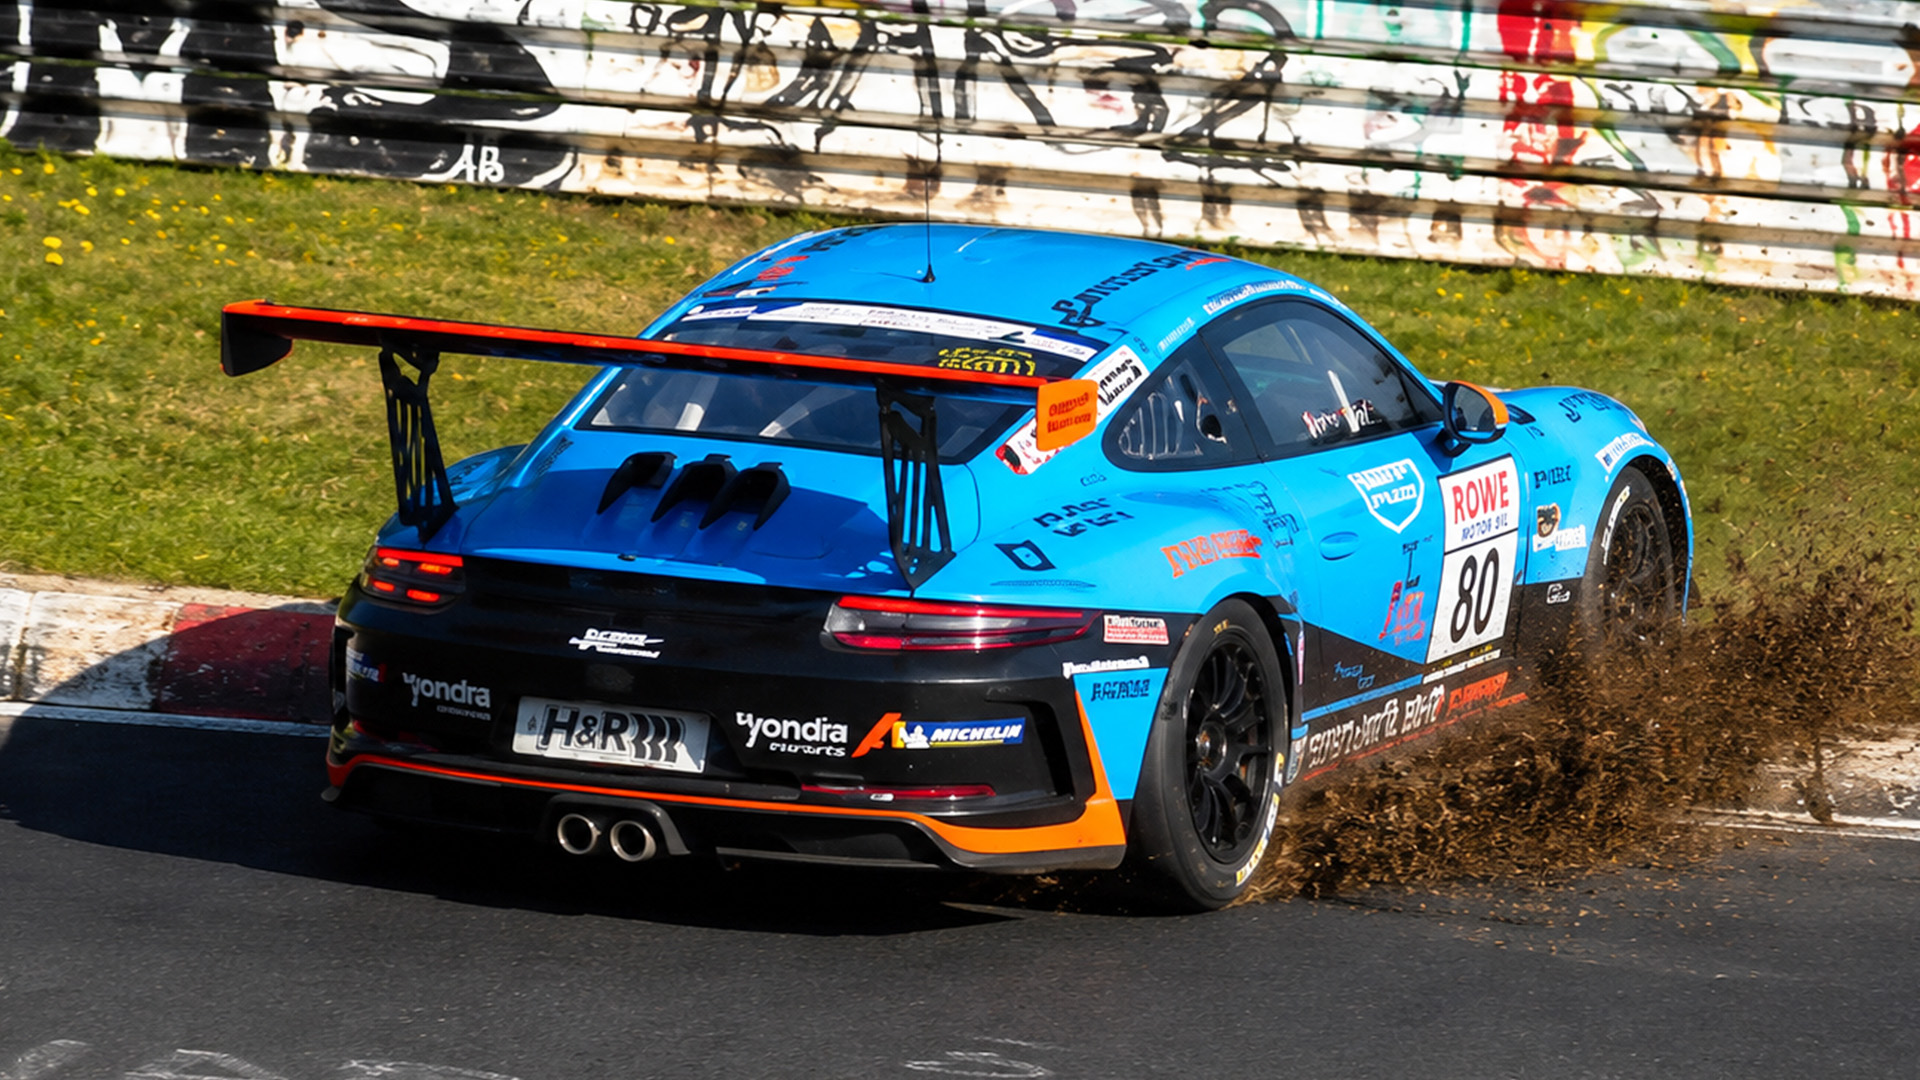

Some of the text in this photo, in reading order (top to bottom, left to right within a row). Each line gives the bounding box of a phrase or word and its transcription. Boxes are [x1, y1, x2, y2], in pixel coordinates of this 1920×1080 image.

[1452, 470, 1509, 525] ROWE
[1450, 547, 1500, 643] 80
[402, 671, 491, 708] yondra
[540, 705, 630, 752] H&R
[736, 711, 848, 748] yondra
[930, 724, 1022, 742] MICHELIN
